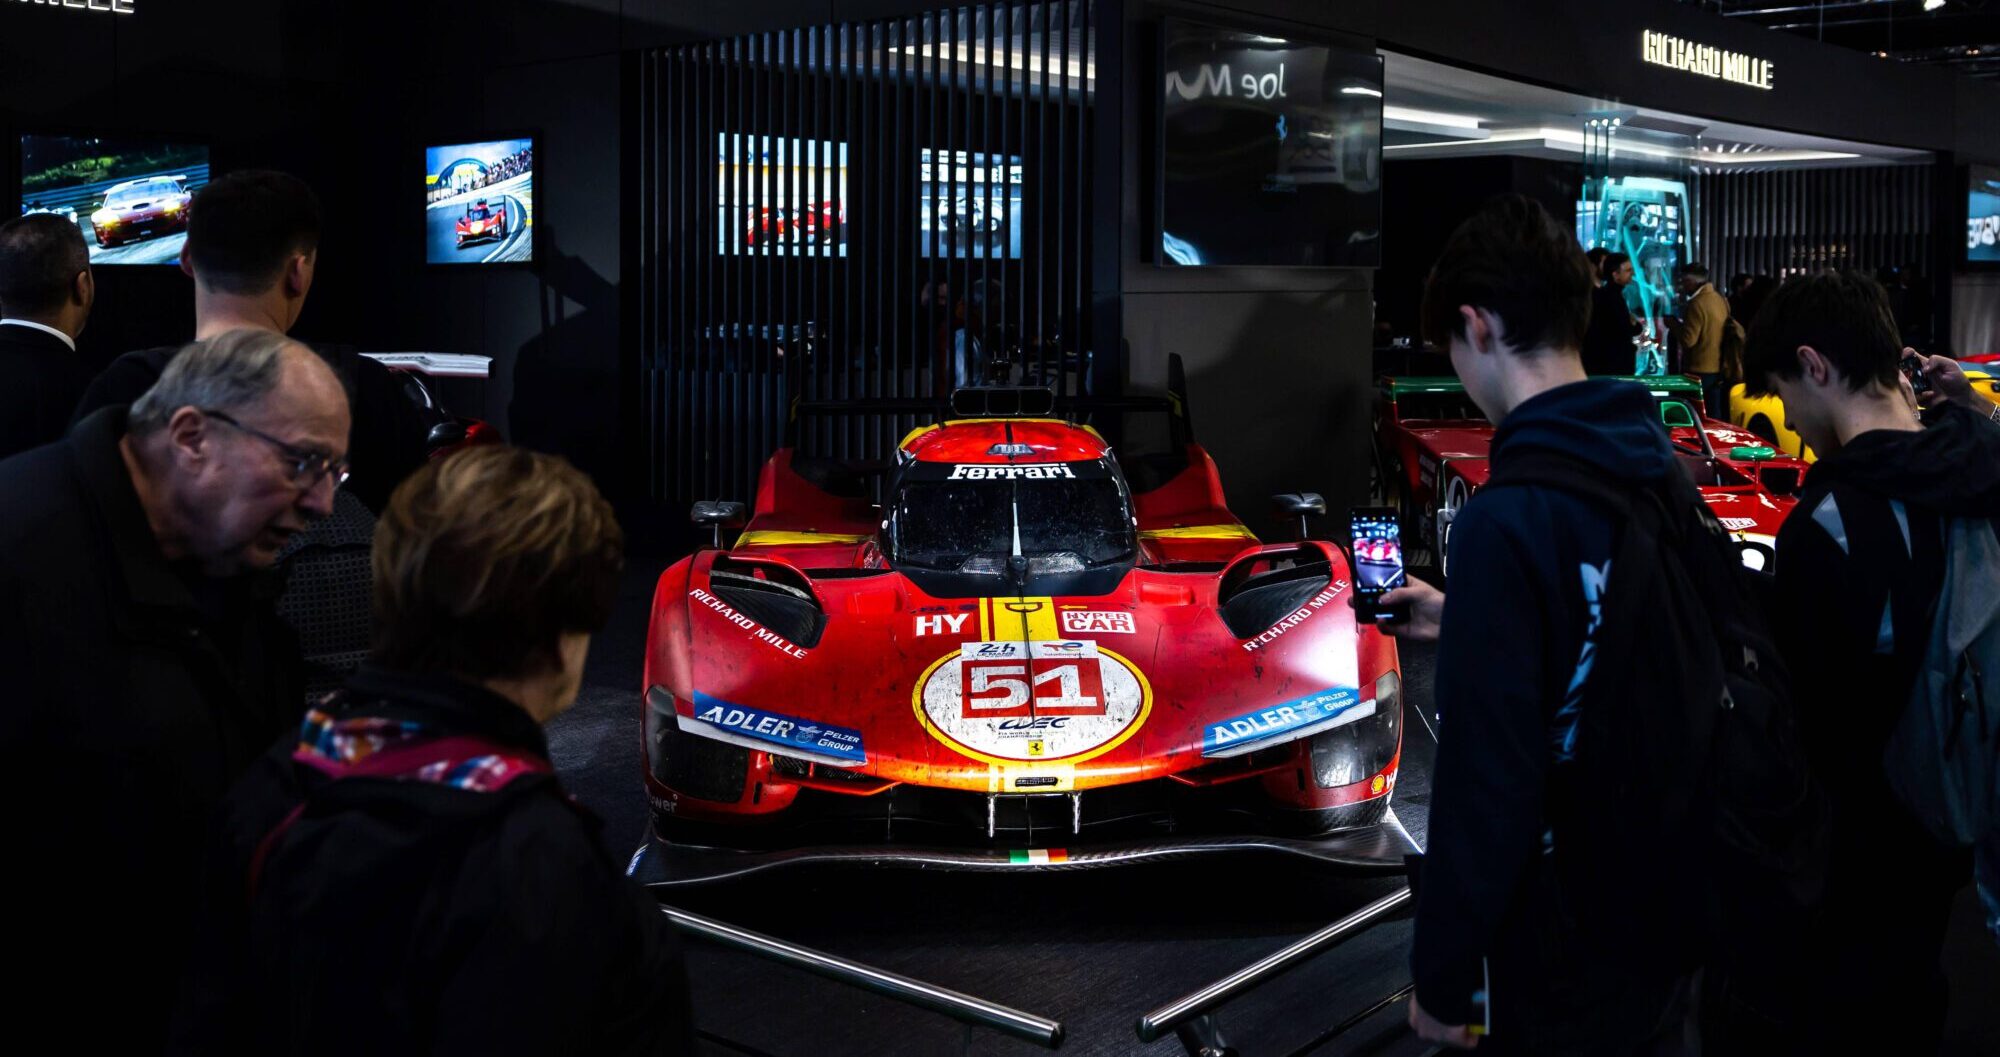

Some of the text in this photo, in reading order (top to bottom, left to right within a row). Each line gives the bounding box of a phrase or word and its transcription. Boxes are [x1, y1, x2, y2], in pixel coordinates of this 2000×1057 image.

[1643, 29, 1774, 90] RICHARD MILLE
[946, 463, 1076, 480] Ferrari
[689, 588, 808, 659] RICHARD MILLE
[915, 613, 970, 637] HY
[1066, 612, 1128, 620] HYPER
[1068, 619, 1131, 631] CAR
[1242, 579, 1350, 652] RCHARD MILLE
[969, 664, 1098, 710] 51
[697, 705, 796, 738] ADLER
[998, 717, 1070, 729] WEC
[1213, 706, 1300, 744] ADLER
